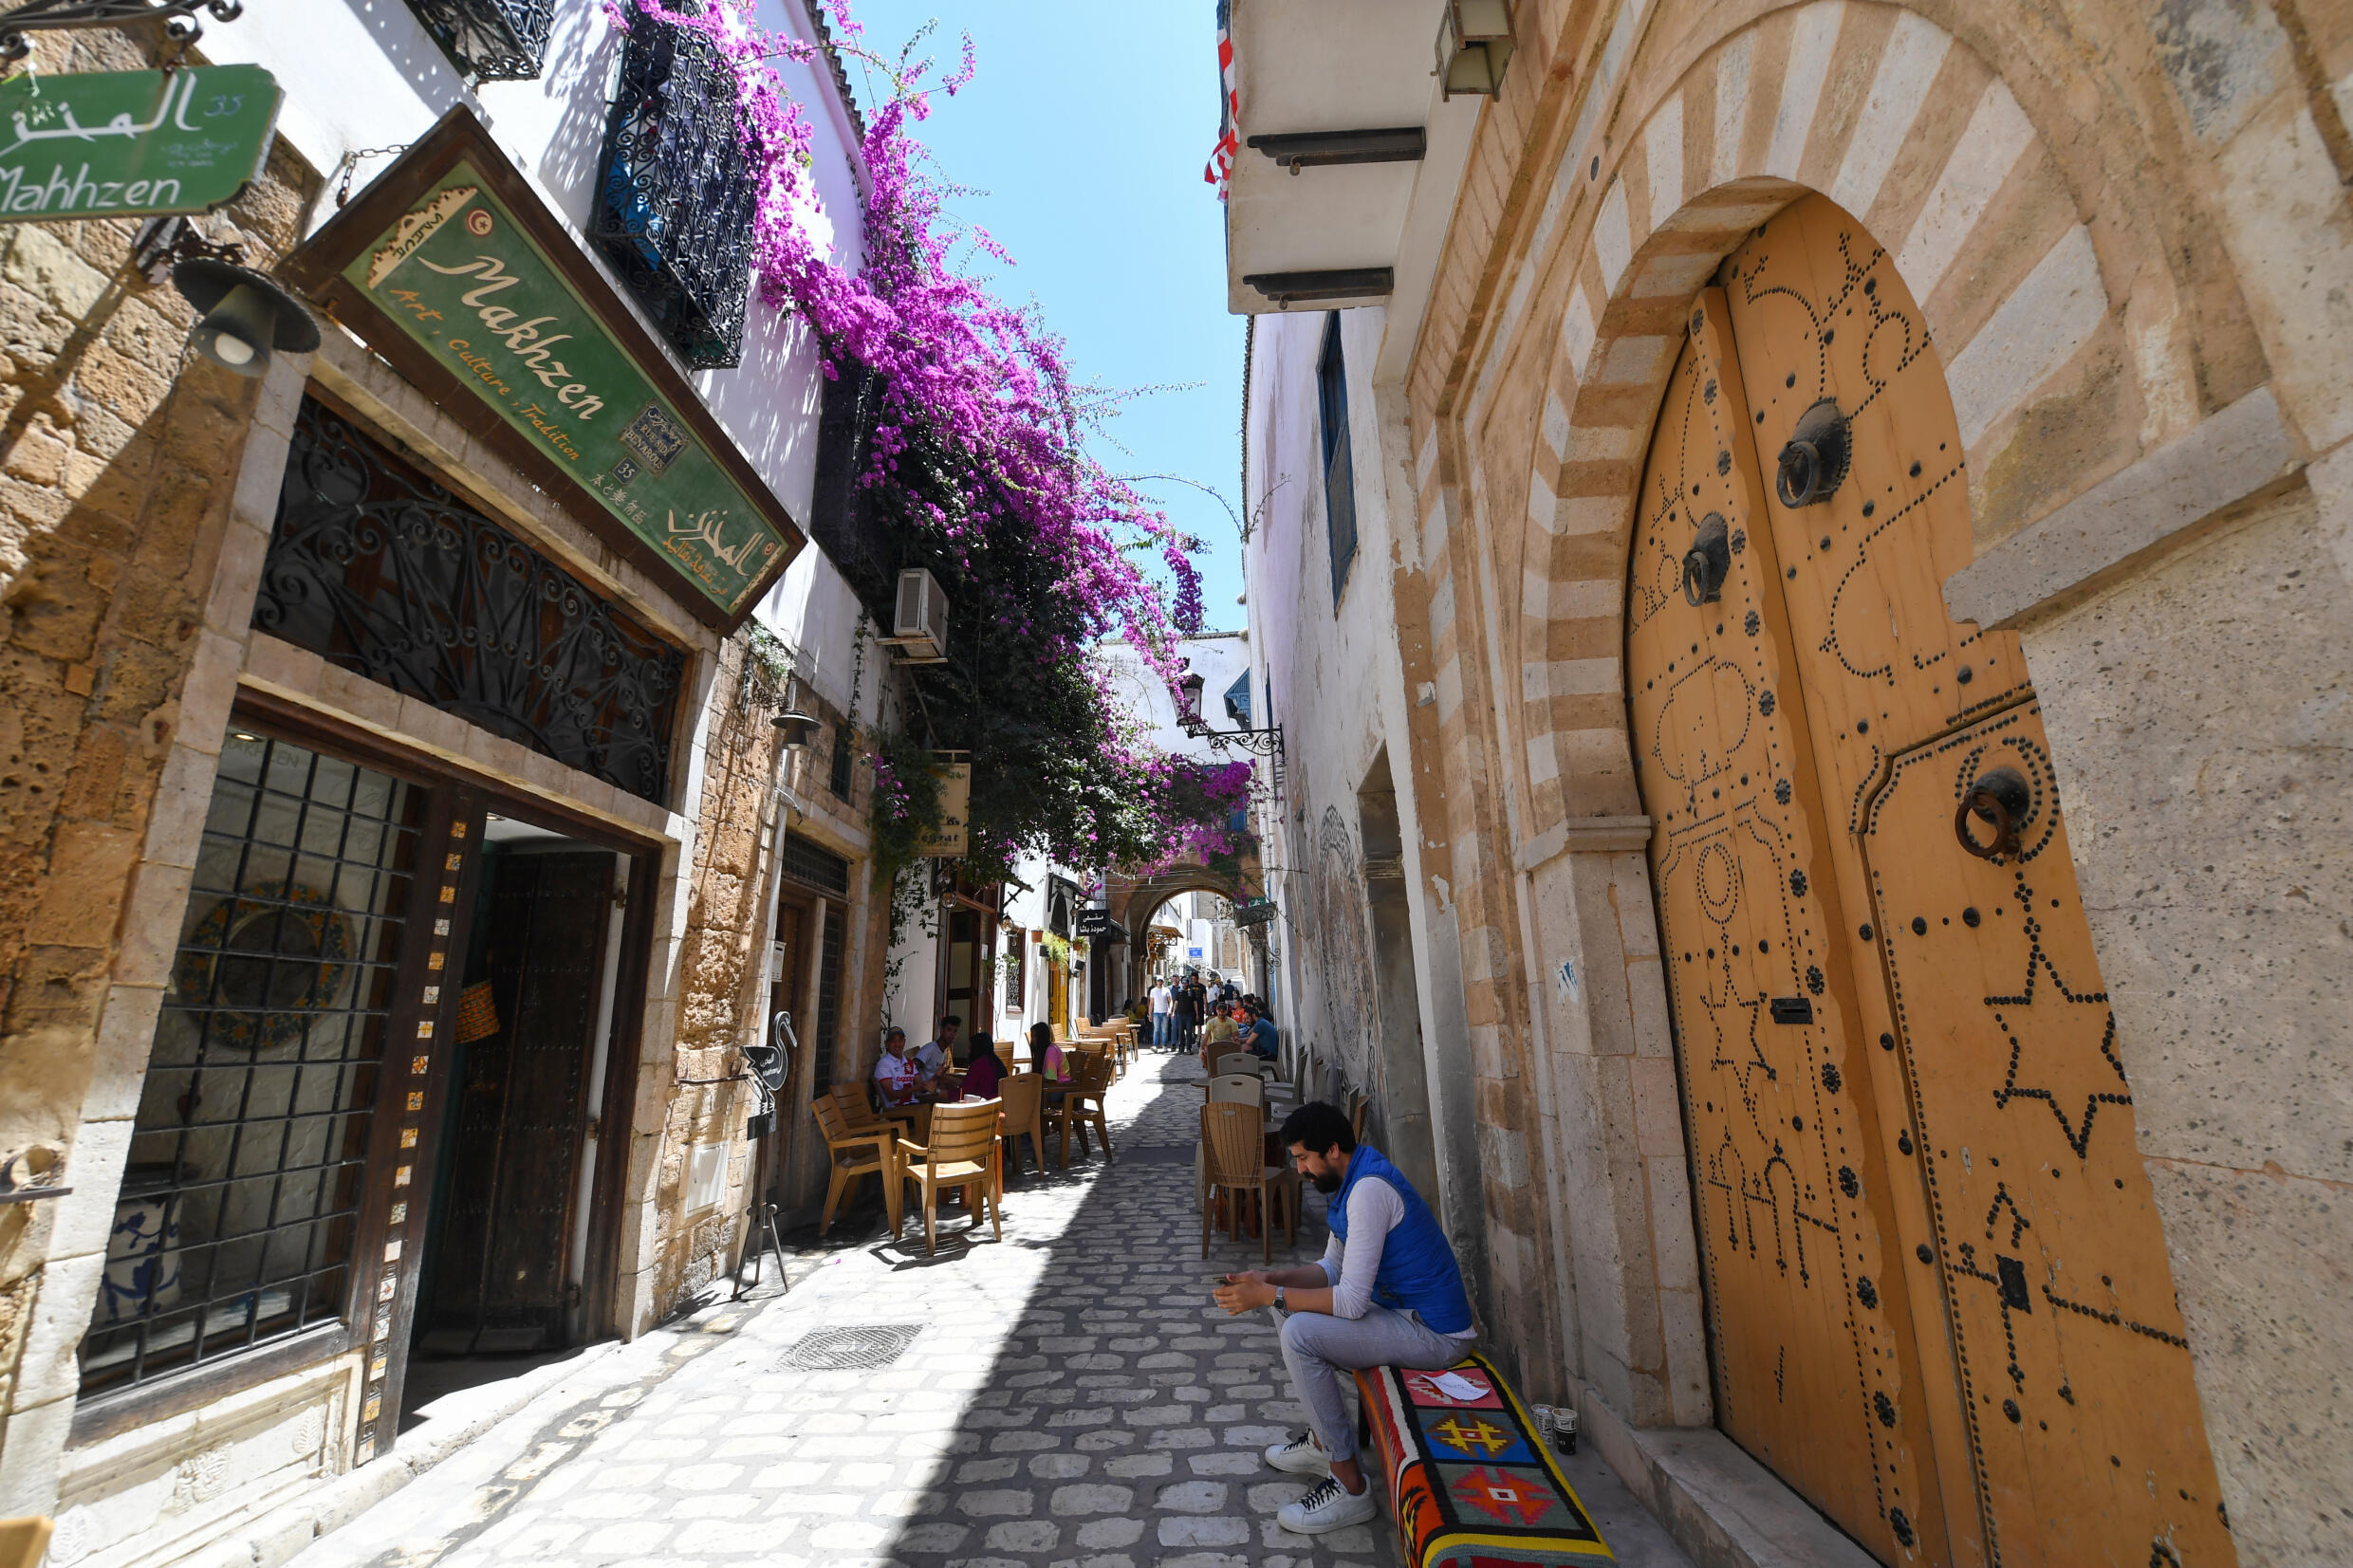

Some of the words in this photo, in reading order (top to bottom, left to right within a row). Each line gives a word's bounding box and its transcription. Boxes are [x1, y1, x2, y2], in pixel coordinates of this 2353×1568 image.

[417, 255, 604, 419] Makhzen
[520, 402, 580, 461] Tradition
[626, 429, 642, 449] BEN
[639, 444, 663, 470] AROUS
[639, 424, 658, 443] RUE
[655, 439, 670, 457] SIDI
[618, 463, 636, 478] 35
